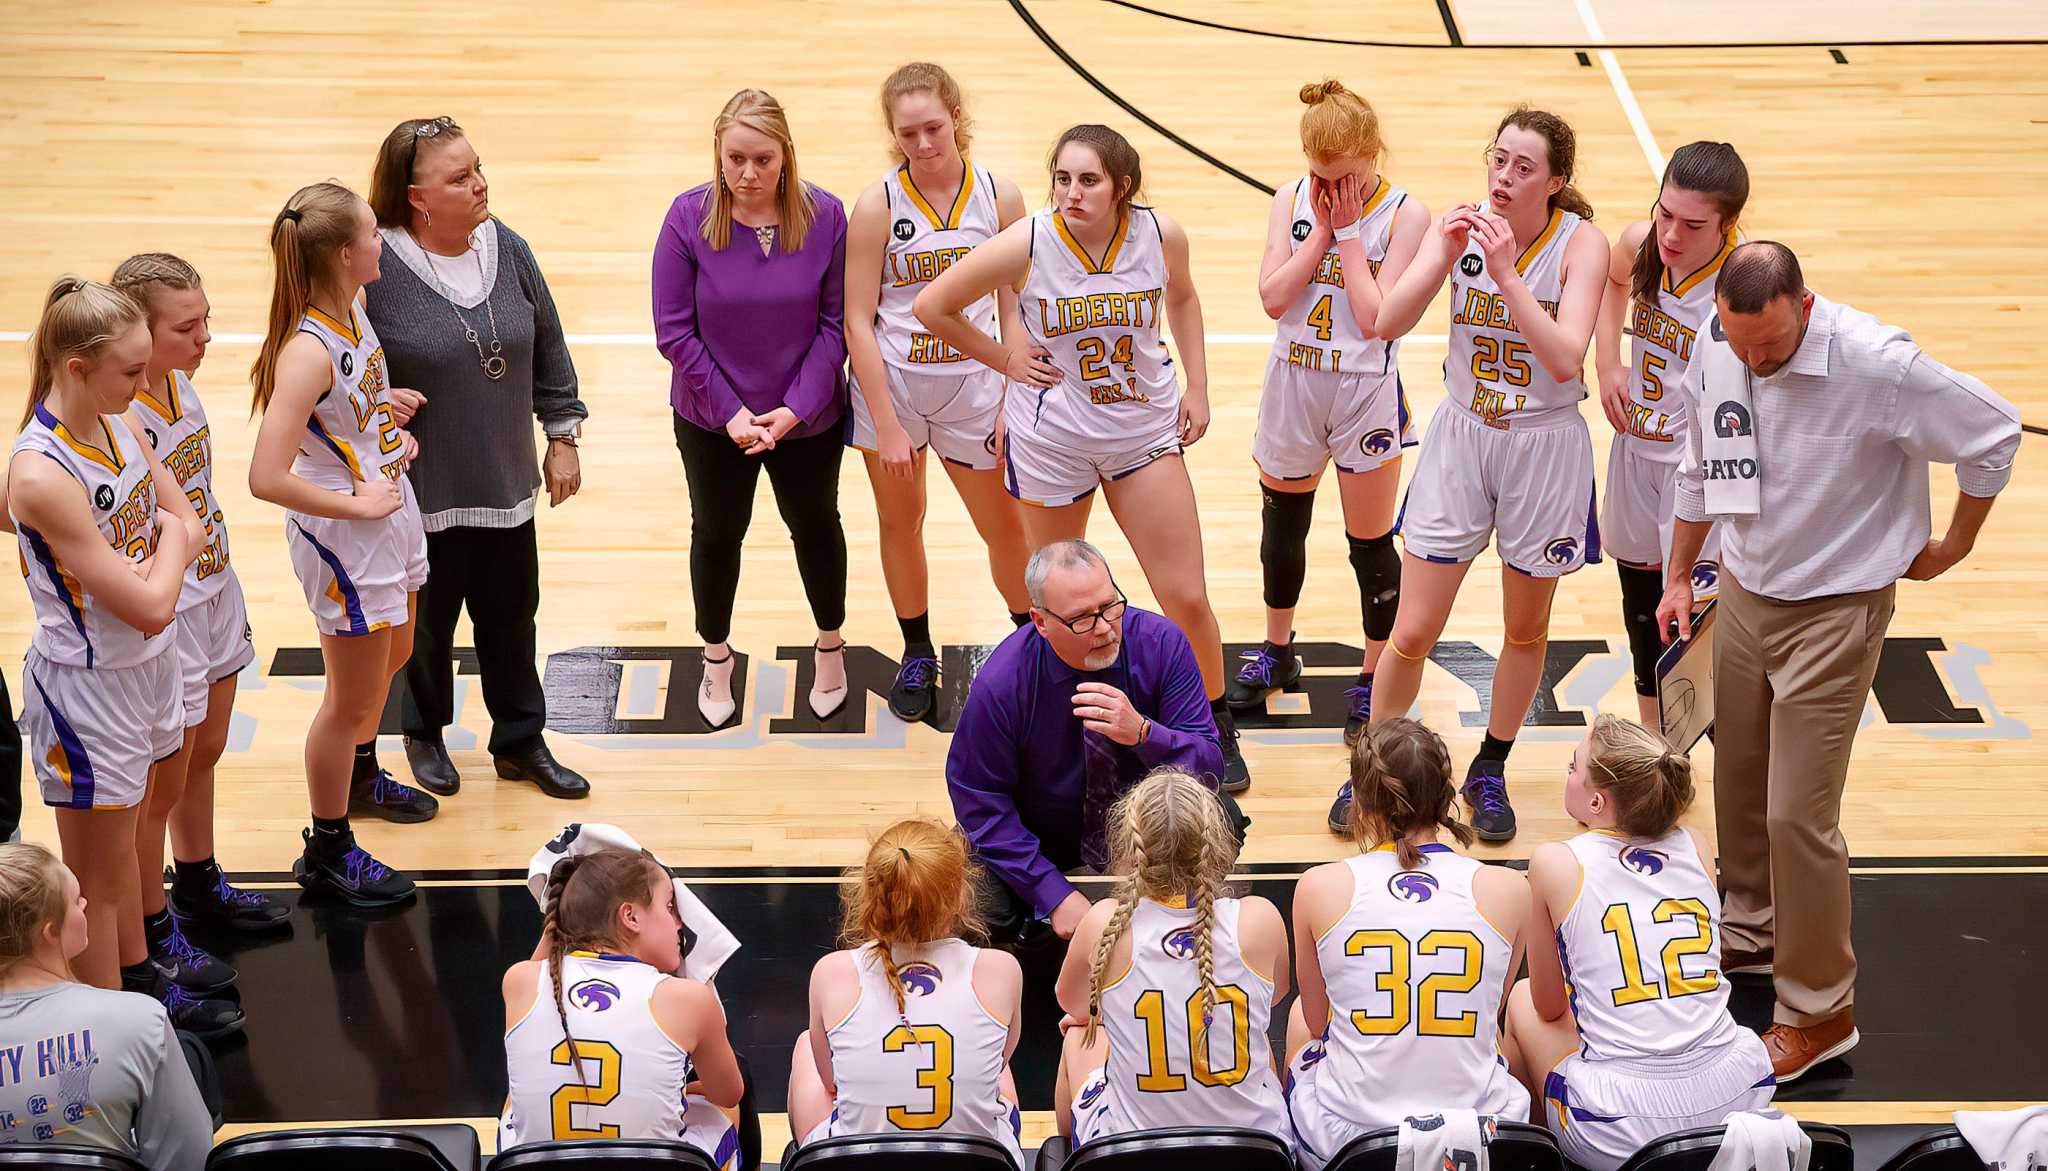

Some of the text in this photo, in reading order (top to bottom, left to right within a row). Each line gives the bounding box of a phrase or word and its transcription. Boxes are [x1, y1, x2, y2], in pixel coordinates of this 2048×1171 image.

[1038, 288, 1162, 338] LIBERTY
[1307, 294, 1333, 341] 4
[1076, 335, 1136, 381] 24
[1471, 335, 1532, 387] 25
[1642, 350, 1667, 401] 5
[1344, 929, 1484, 1038] 32
[1601, 898, 1720, 1007] 12
[1134, 984, 1250, 1093] 10
[550, 1039, 622, 1140] 2
[882, 1024, 954, 1131] 3
